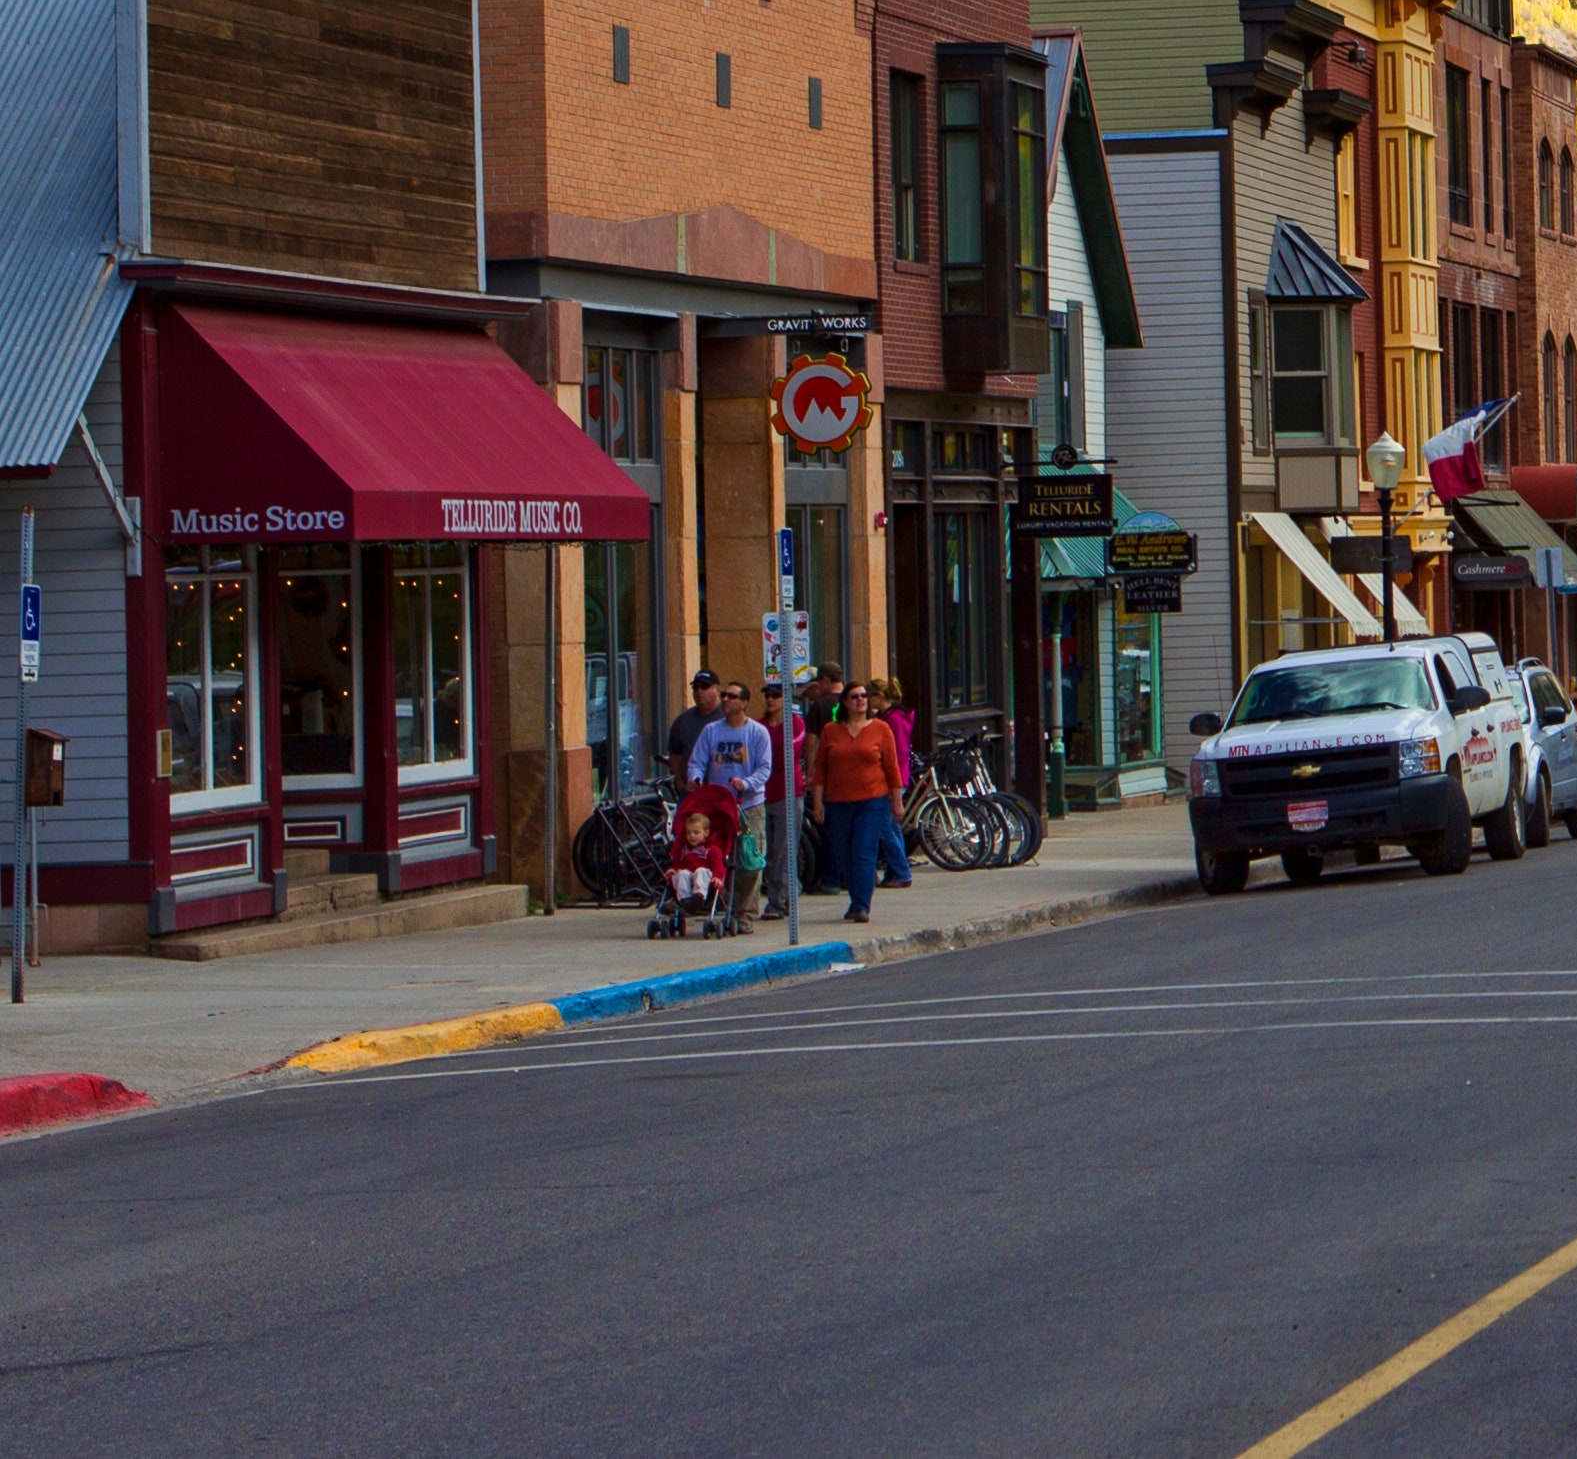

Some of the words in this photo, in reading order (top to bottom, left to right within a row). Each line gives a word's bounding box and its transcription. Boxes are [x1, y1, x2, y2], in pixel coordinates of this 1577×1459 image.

[821, 316, 867, 330] WORKS
[1034, 483, 1094, 496] TELLURIDE
[1028, 501, 1102, 516] RENTALS
[170, 508, 259, 534] Music
[266, 506, 345, 532] Store
[441, 499, 516, 532] TELLURIDE
[519, 500, 560, 534] MUSIC
[562, 501, 582, 534] CO.
[1046, 520, 1081, 528] VACATION
[1082, 520, 1114, 528] RENTALS
[1142, 534, 1188, 546] Andrews
[1116, 546, 1137, 554] REAL
[1171, 544, 1184, 553] CO.
[1126, 577, 1151, 591] HELL
[1153, 576, 1179, 590] BENT
[1127, 590, 1178, 600] LEATHER
[1137, 604, 1170, 612] SILVER
[1229, 745, 1250, 758] MTN
